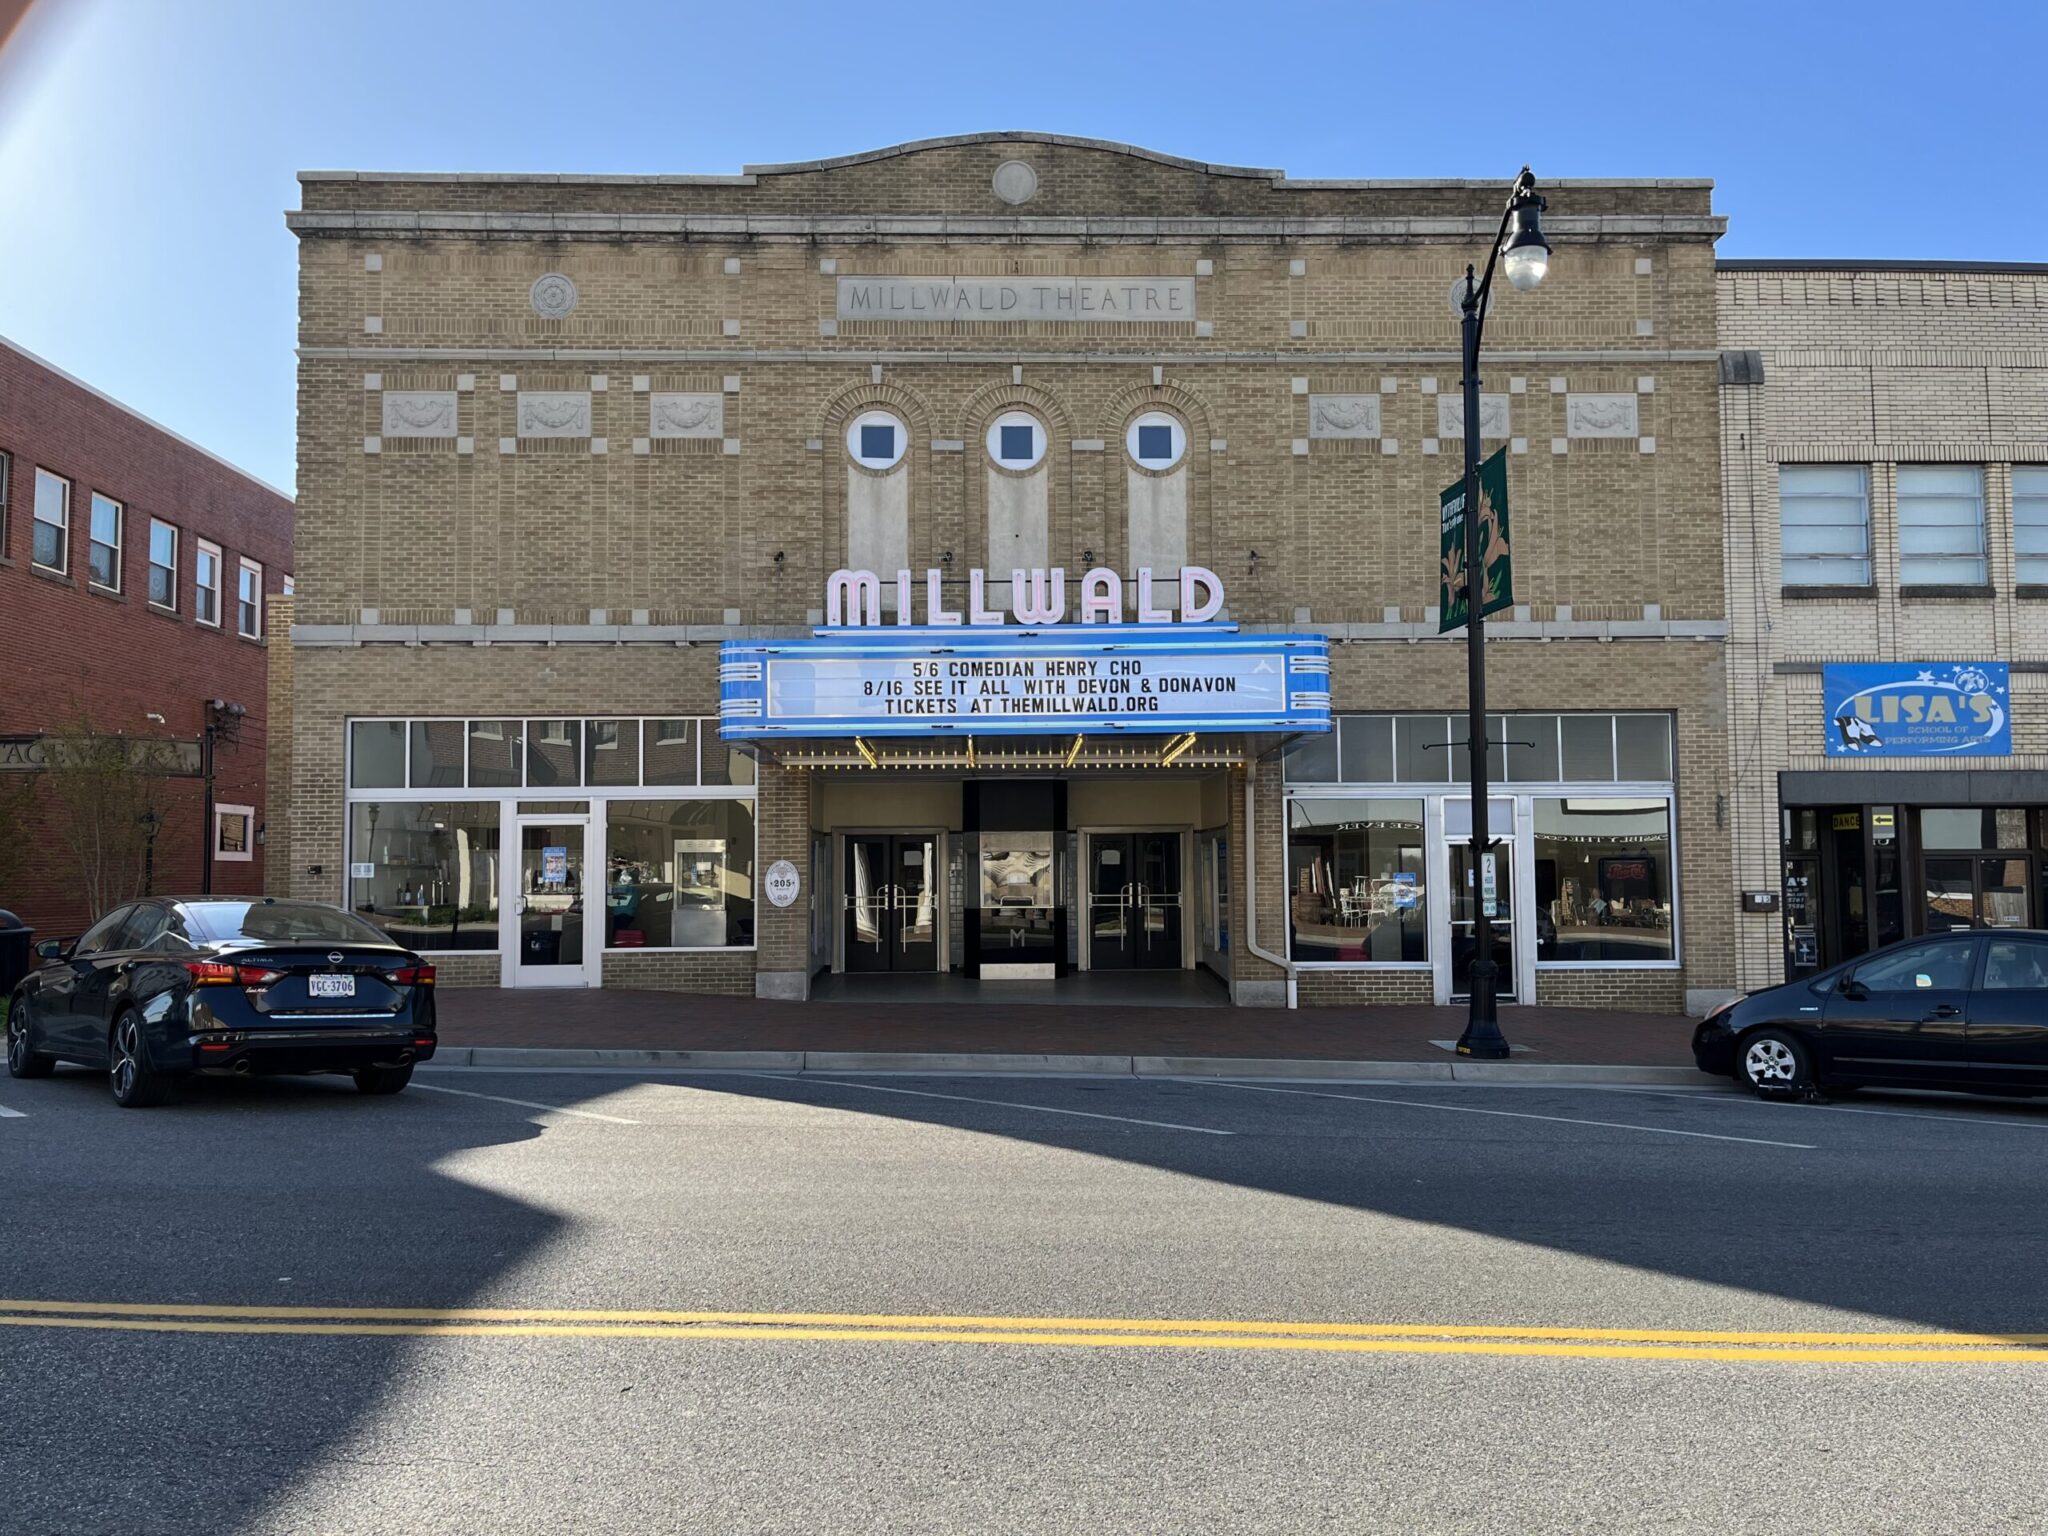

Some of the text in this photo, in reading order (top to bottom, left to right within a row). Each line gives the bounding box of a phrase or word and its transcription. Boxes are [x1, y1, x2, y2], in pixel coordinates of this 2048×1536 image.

[850, 286, 1184, 311] MILLWALD THEATRE
[827, 565, 1225, 626] MILLWALD
[912, 660, 1142, 677] 5/6 COMEDIAN HENRY CHO
[863, 677, 1236, 696] 8/16 SEE IT ALL WITH DEVON & DONAVON
[885, 696, 1158, 714] TICKETS AT THEMILLWALD.ORG
[1854, 694, 1993, 723] LISA'S
[1908, 726, 1969, 734] SCHOOL OF
[1885, 735, 1991, 745] PERFORMING ARTS
[1833, 815, 1860, 828] DANCE
[1486, 857, 1492, 873] 2
[774, 879, 792, 888] 205
[1010, 928, 1025, 948] M
